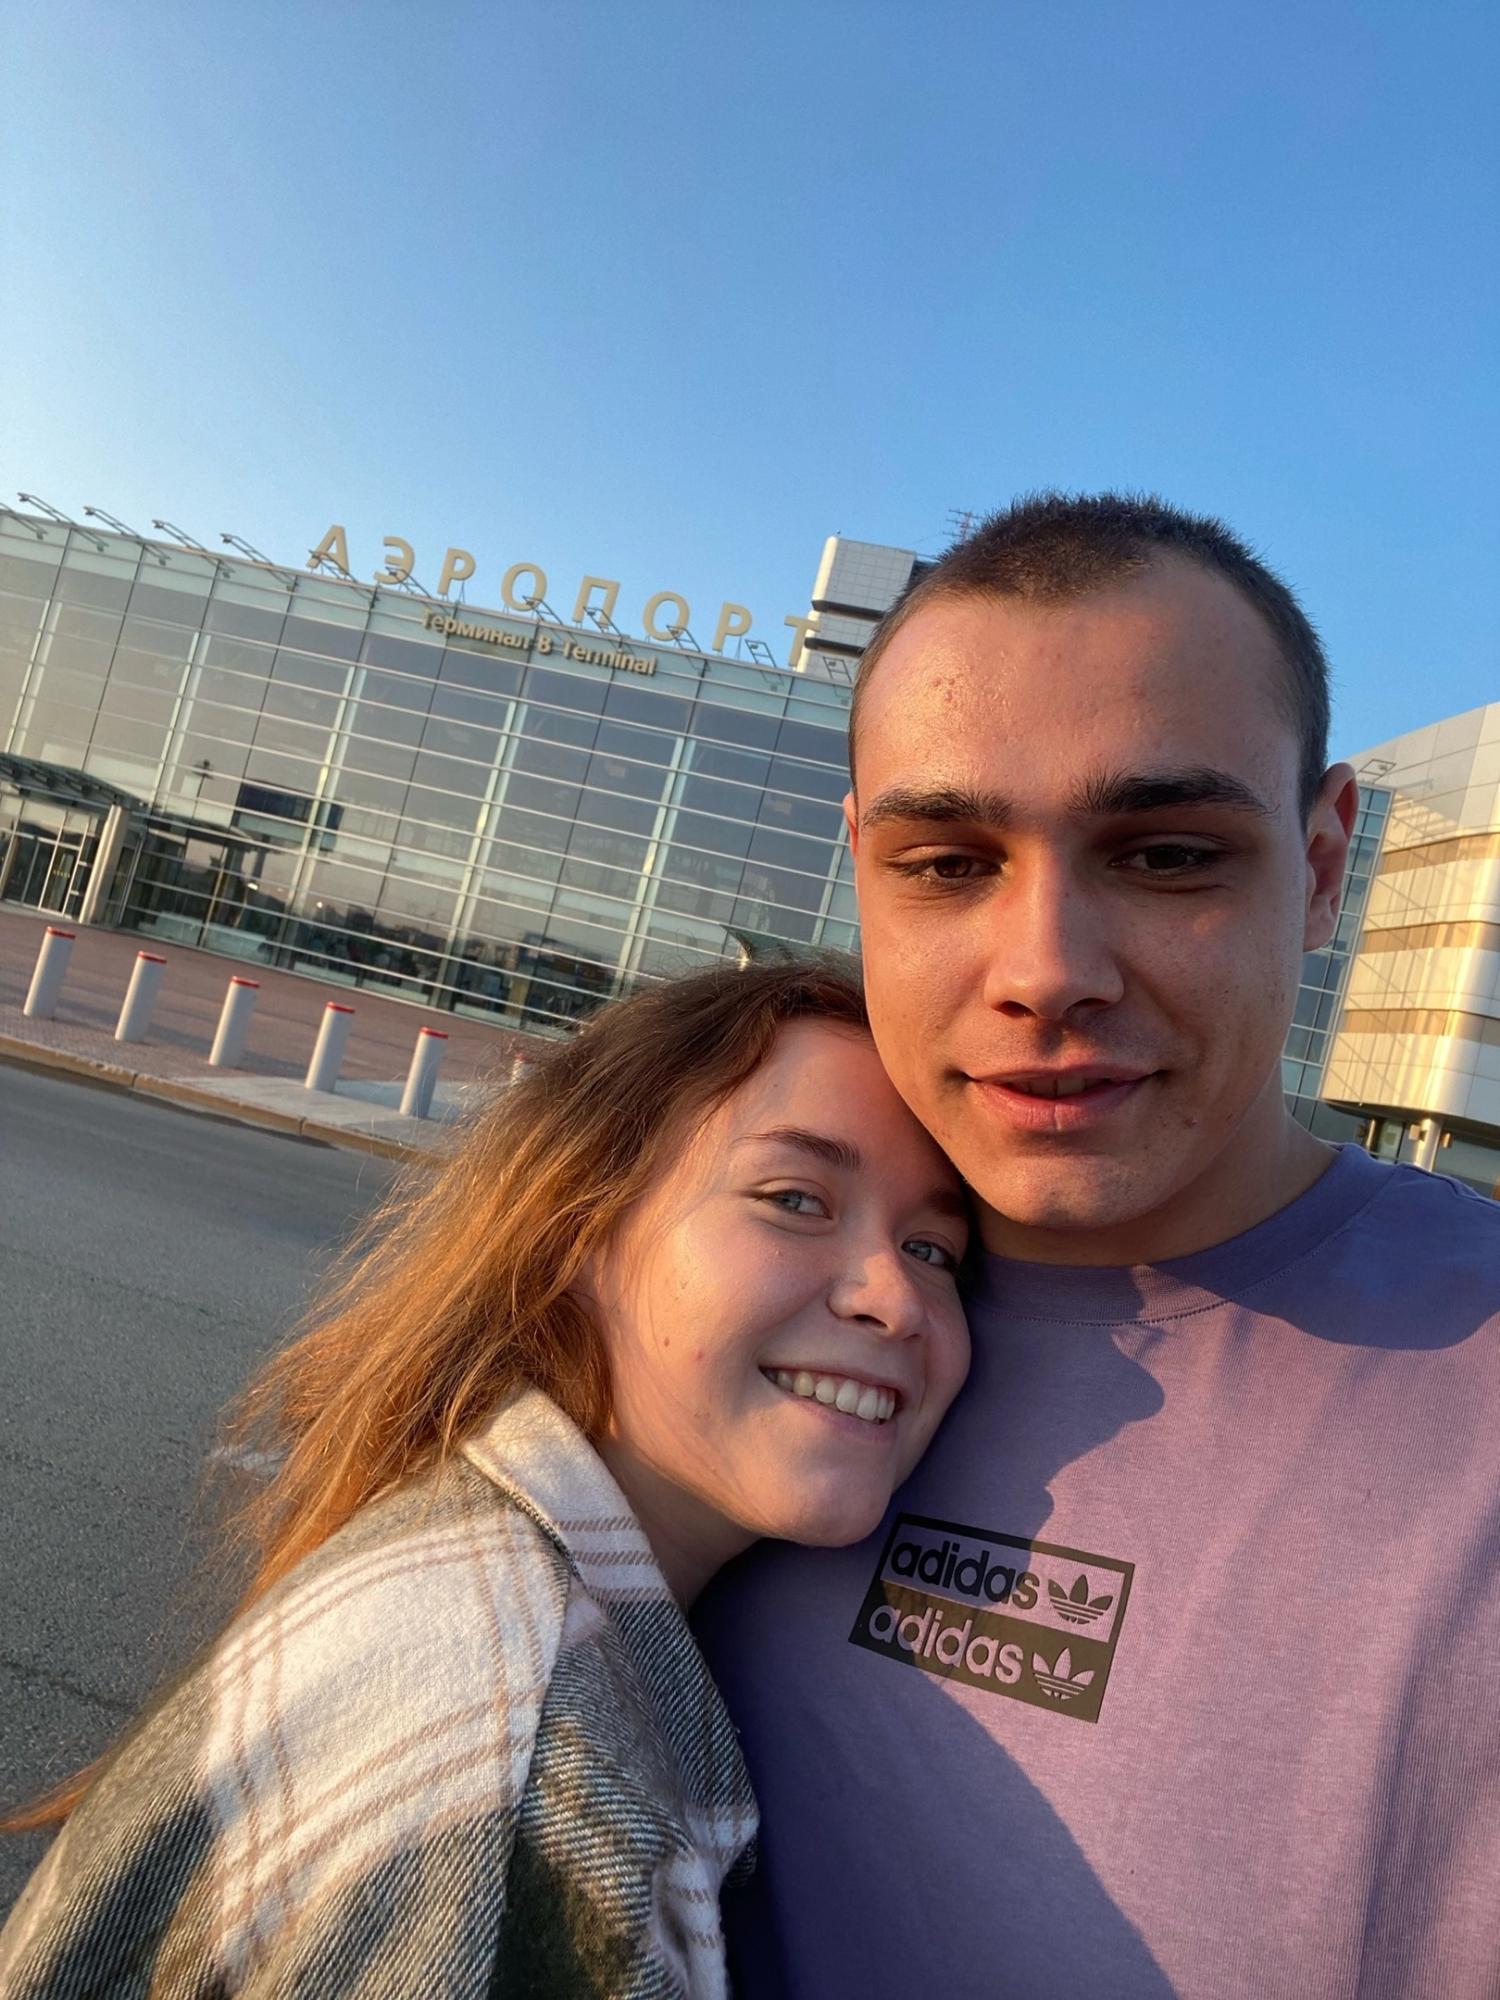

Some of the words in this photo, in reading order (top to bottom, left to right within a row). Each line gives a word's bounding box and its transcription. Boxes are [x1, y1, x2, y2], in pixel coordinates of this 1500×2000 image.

[305, 524, 821, 668] АЭРОПОРТ
[421, 607, 529, 650] Терминал
[562, 637, 657, 675] Terminal
[890, 1540, 1040, 1610] adidas
[868, 1604, 1024, 1684] adidas
